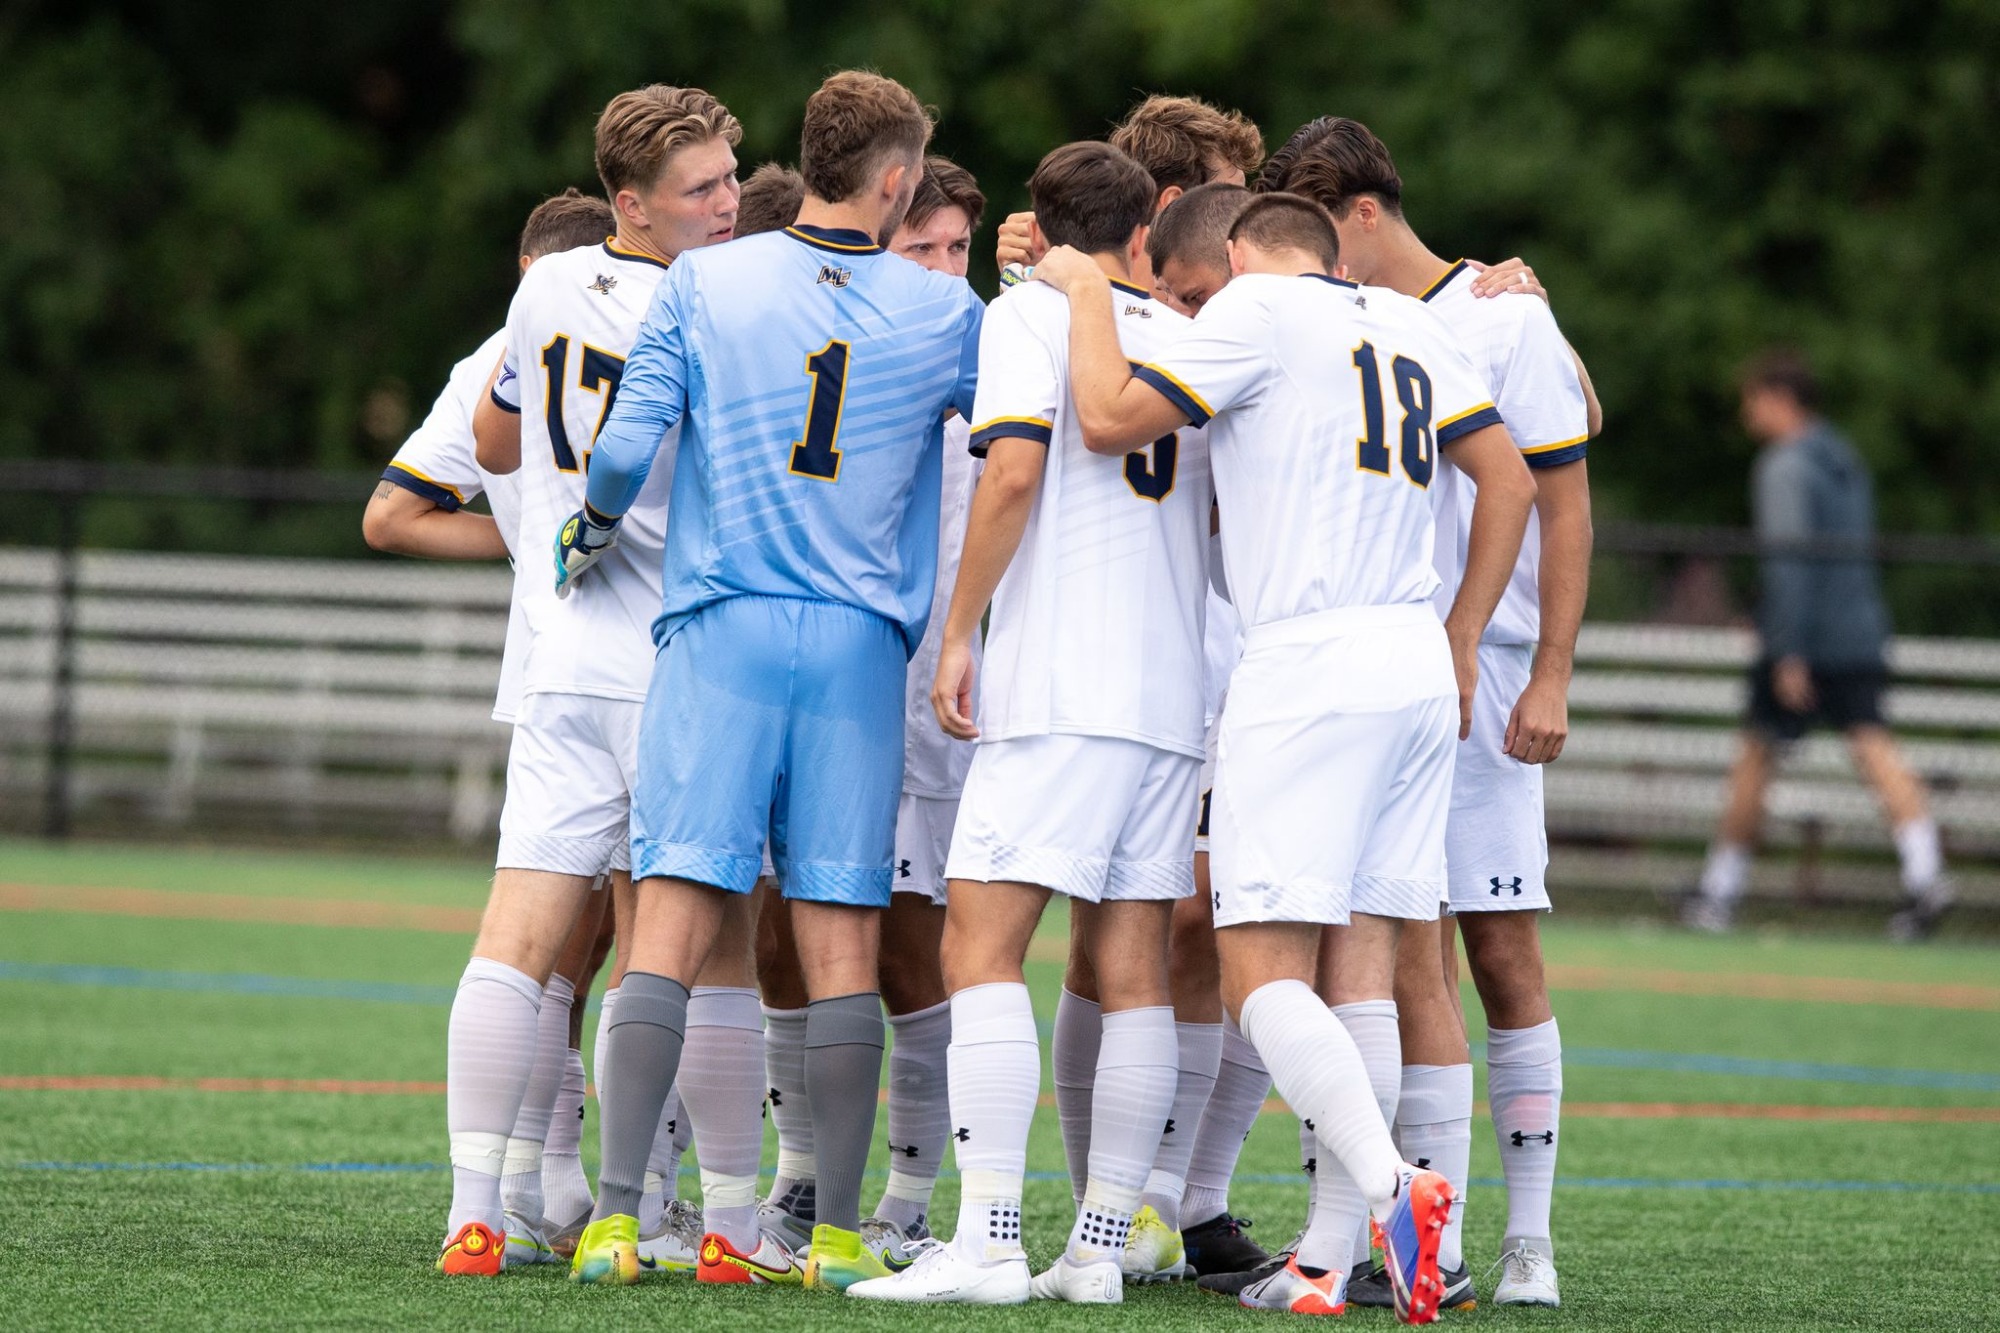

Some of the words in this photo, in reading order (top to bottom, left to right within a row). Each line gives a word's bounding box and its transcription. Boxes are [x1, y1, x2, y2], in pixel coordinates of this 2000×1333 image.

[540, 332, 627, 476] 17
[788, 338, 851, 483] 1
[1351, 337, 1434, 491] 18
